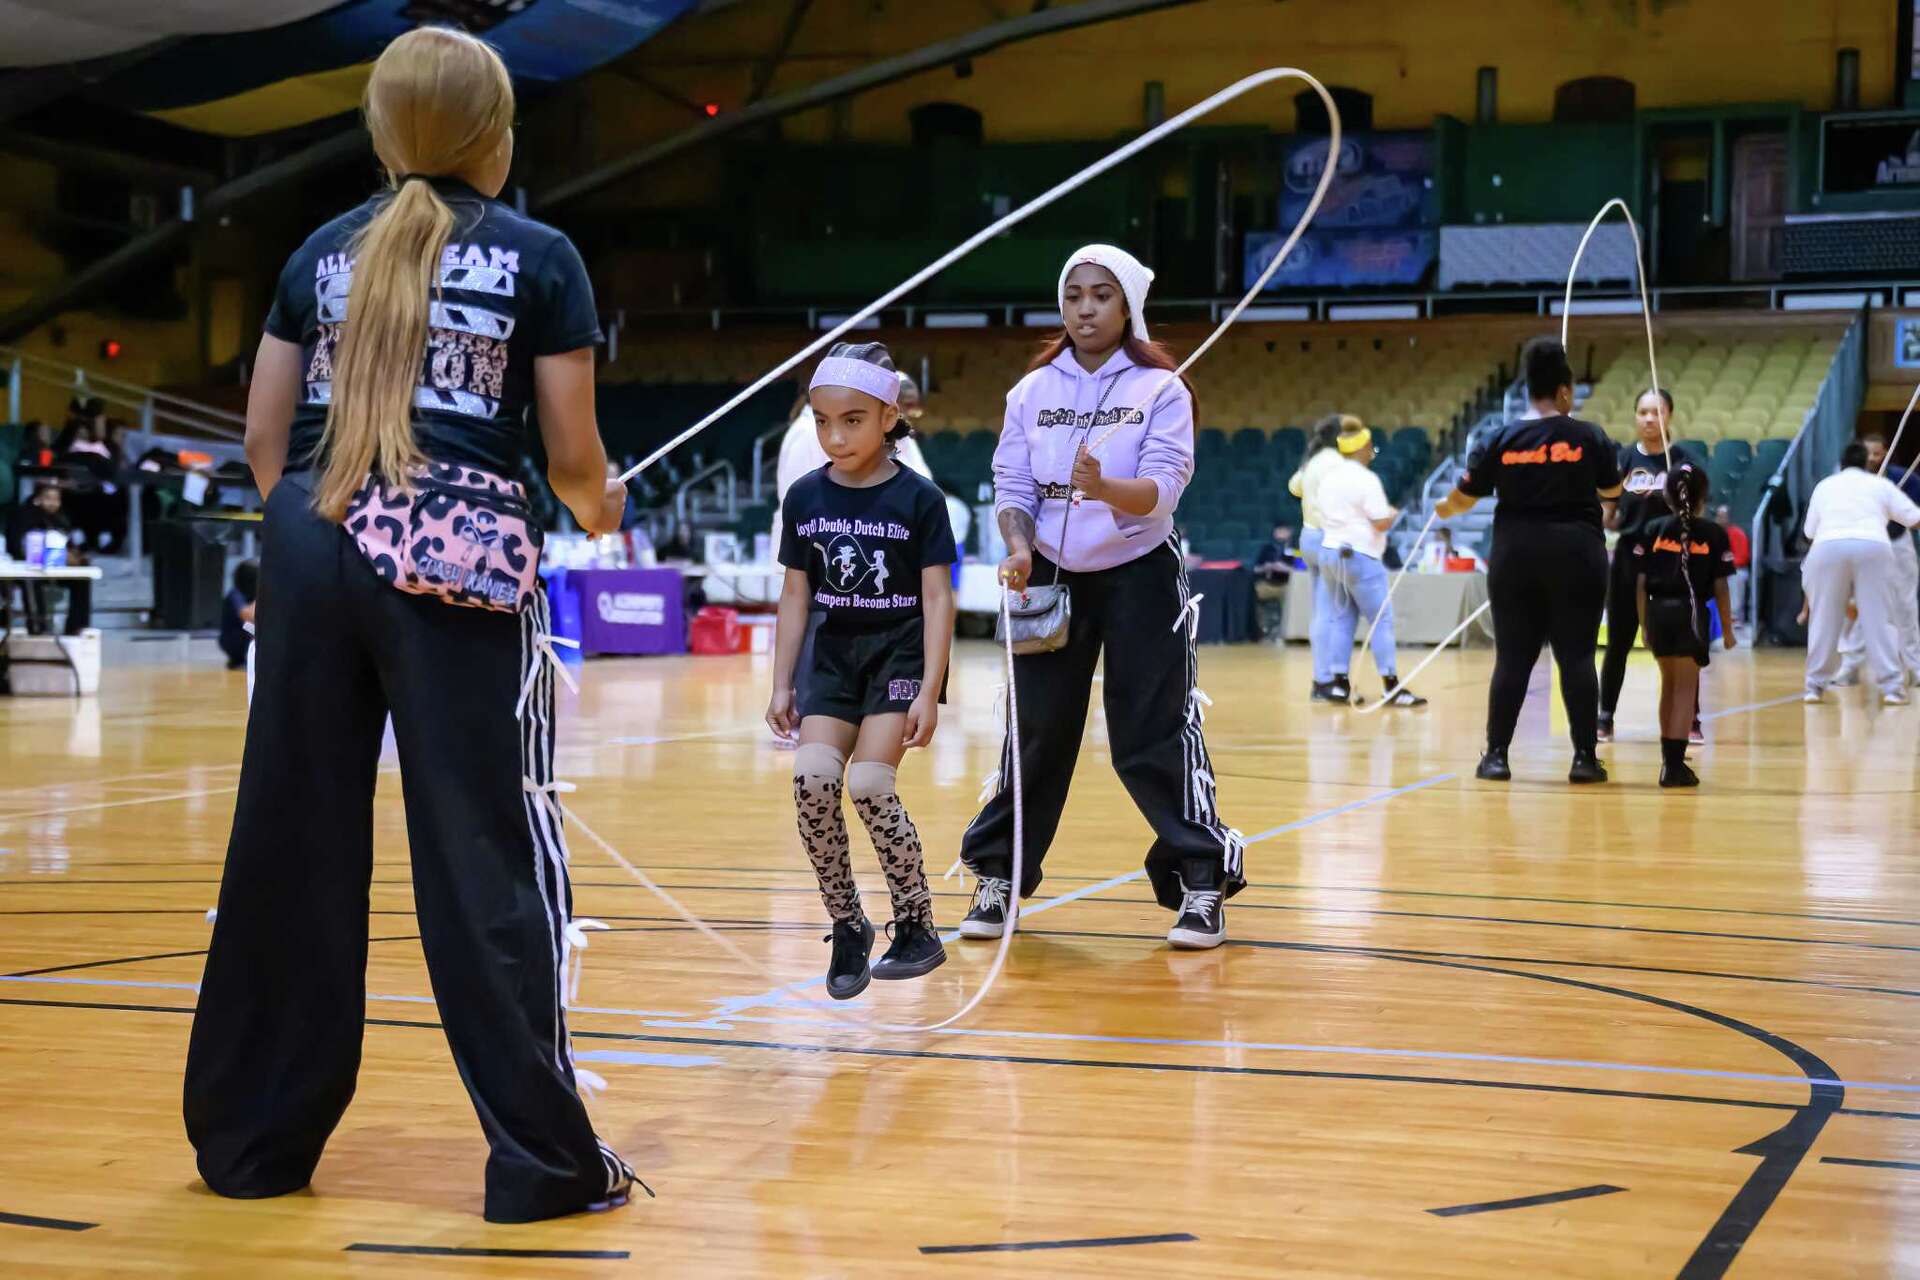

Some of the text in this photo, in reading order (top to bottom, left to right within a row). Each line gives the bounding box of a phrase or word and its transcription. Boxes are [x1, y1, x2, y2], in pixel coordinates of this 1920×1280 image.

[441, 245, 520, 272] EAM
[818, 517, 852, 534] Double
[854, 520, 885, 537] Dutch
[887, 523, 910, 541] Elite
[852, 594, 890, 609] Become
[892, 594, 918, 609] Stars
